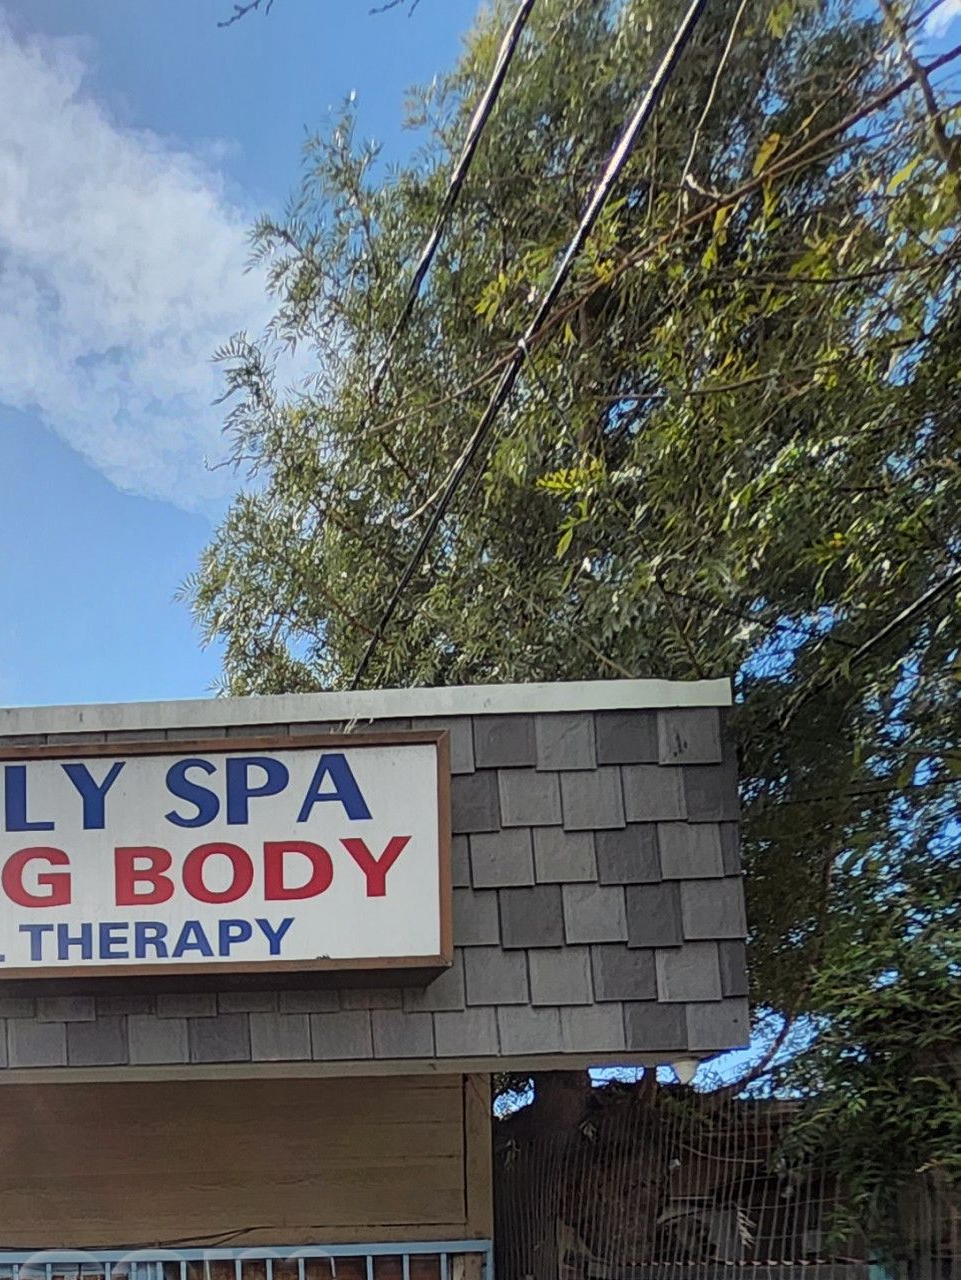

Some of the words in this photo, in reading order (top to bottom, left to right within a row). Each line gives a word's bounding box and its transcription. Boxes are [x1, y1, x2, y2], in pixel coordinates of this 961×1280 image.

[164, 752, 373, 830] SPA
[114, 835, 412, 906] BODY
[19, 917, 295, 961] THERAPY
